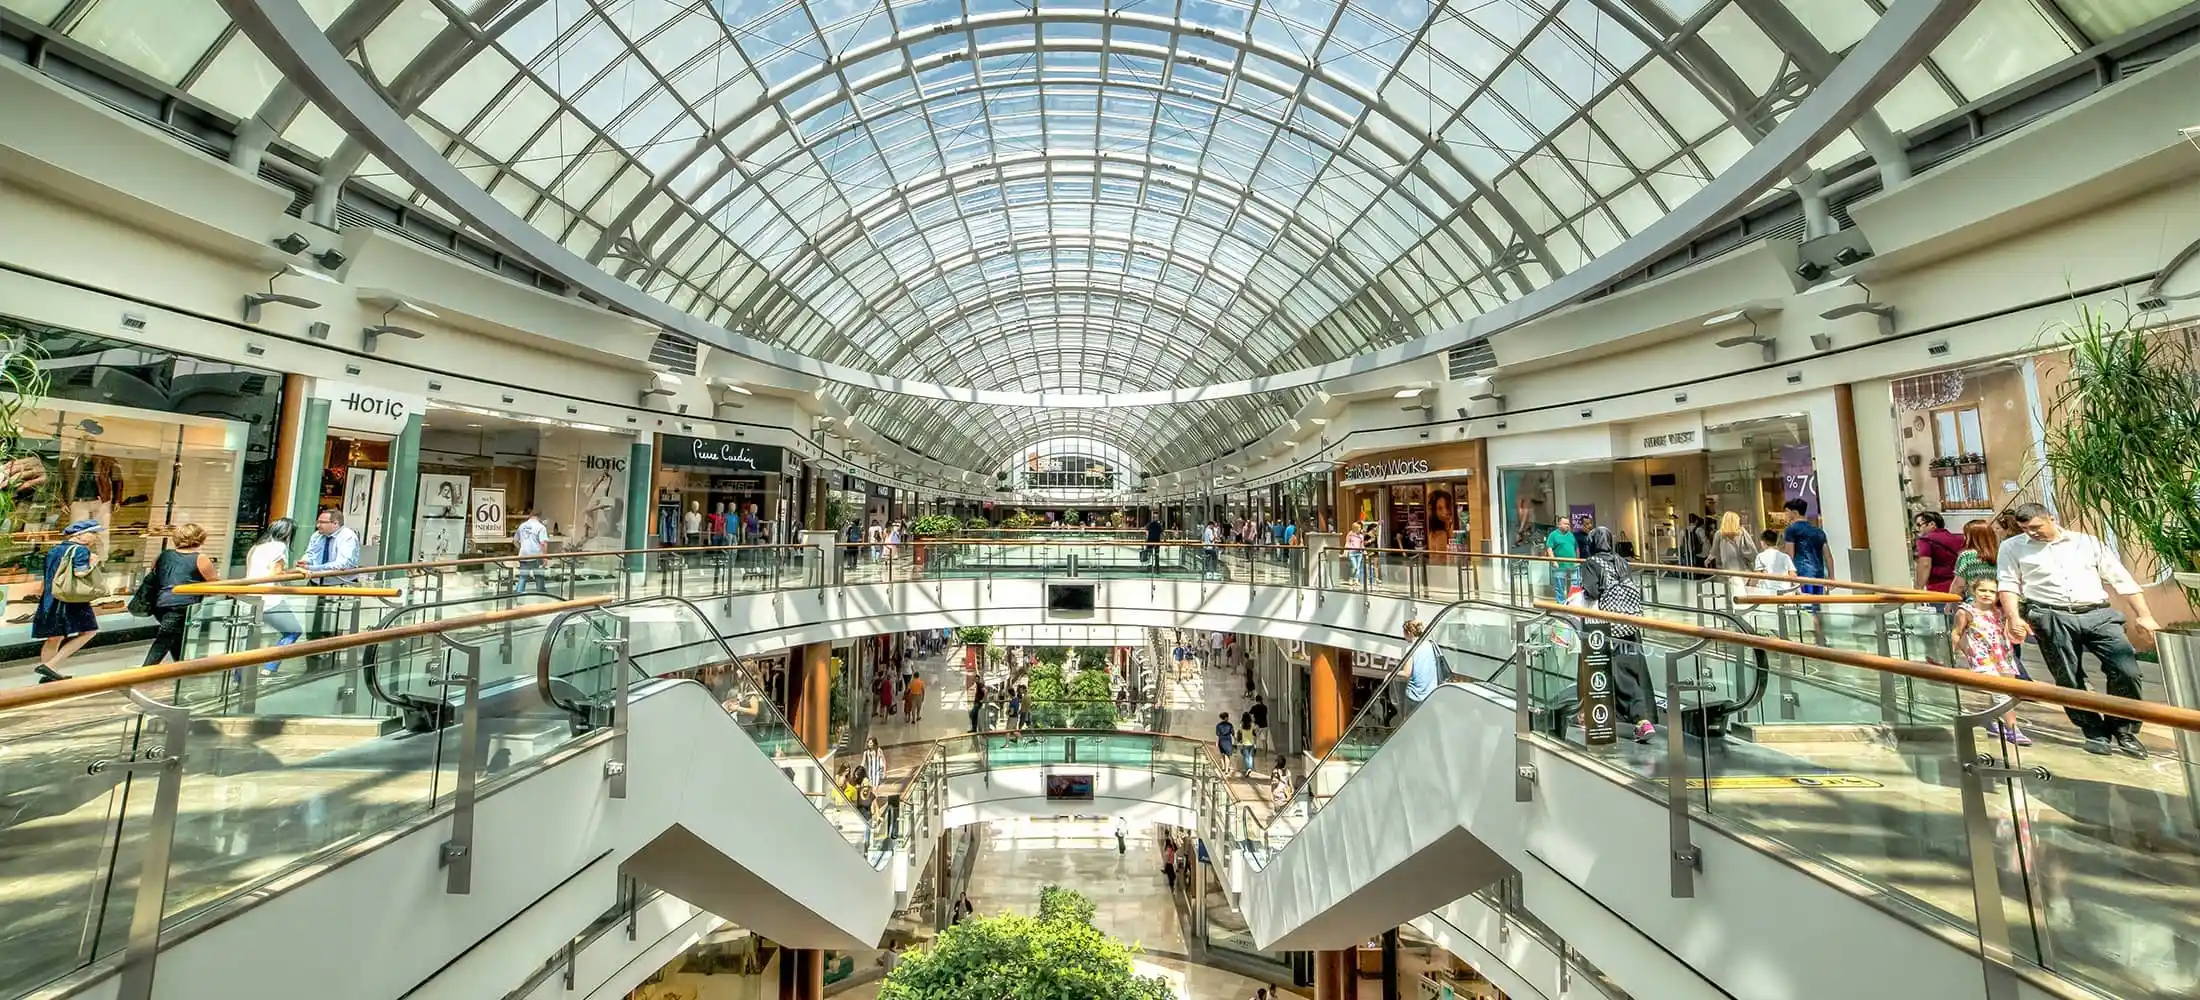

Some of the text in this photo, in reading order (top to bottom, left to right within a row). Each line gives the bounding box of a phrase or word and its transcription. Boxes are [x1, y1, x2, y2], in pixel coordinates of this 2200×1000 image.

[693, 439, 756, 469] Pierre Cardin
[1388, 457, 1429, 475] Works
[476, 503, 500, 523] 60
